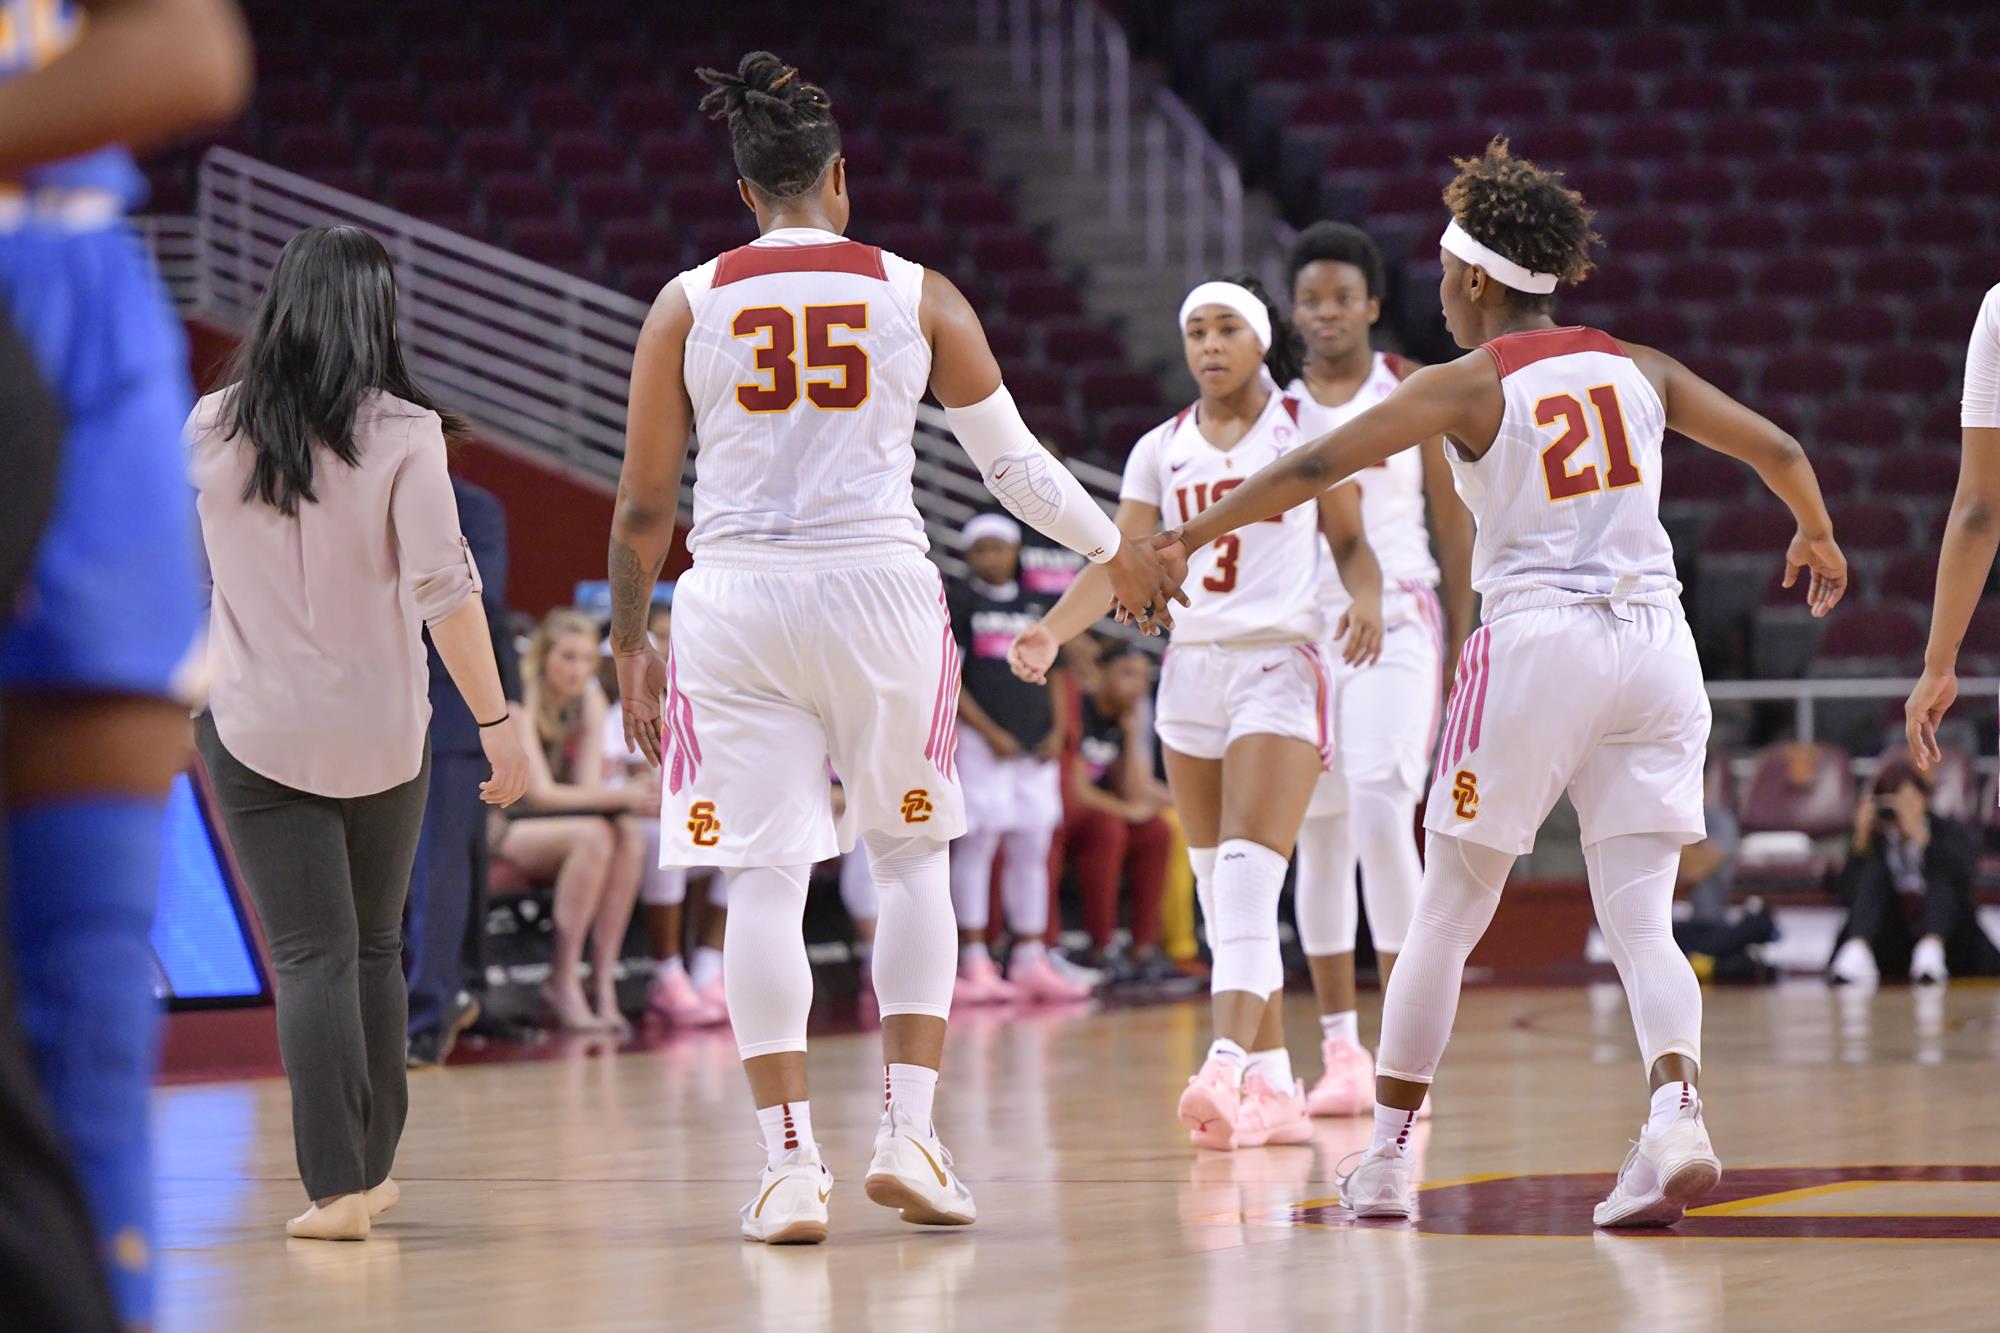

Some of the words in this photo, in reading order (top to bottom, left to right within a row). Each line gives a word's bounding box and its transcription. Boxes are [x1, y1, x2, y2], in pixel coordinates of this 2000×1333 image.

[731, 302, 870, 414] 35
[1532, 384, 1643, 503] 21
[1202, 532, 1240, 593] 3
